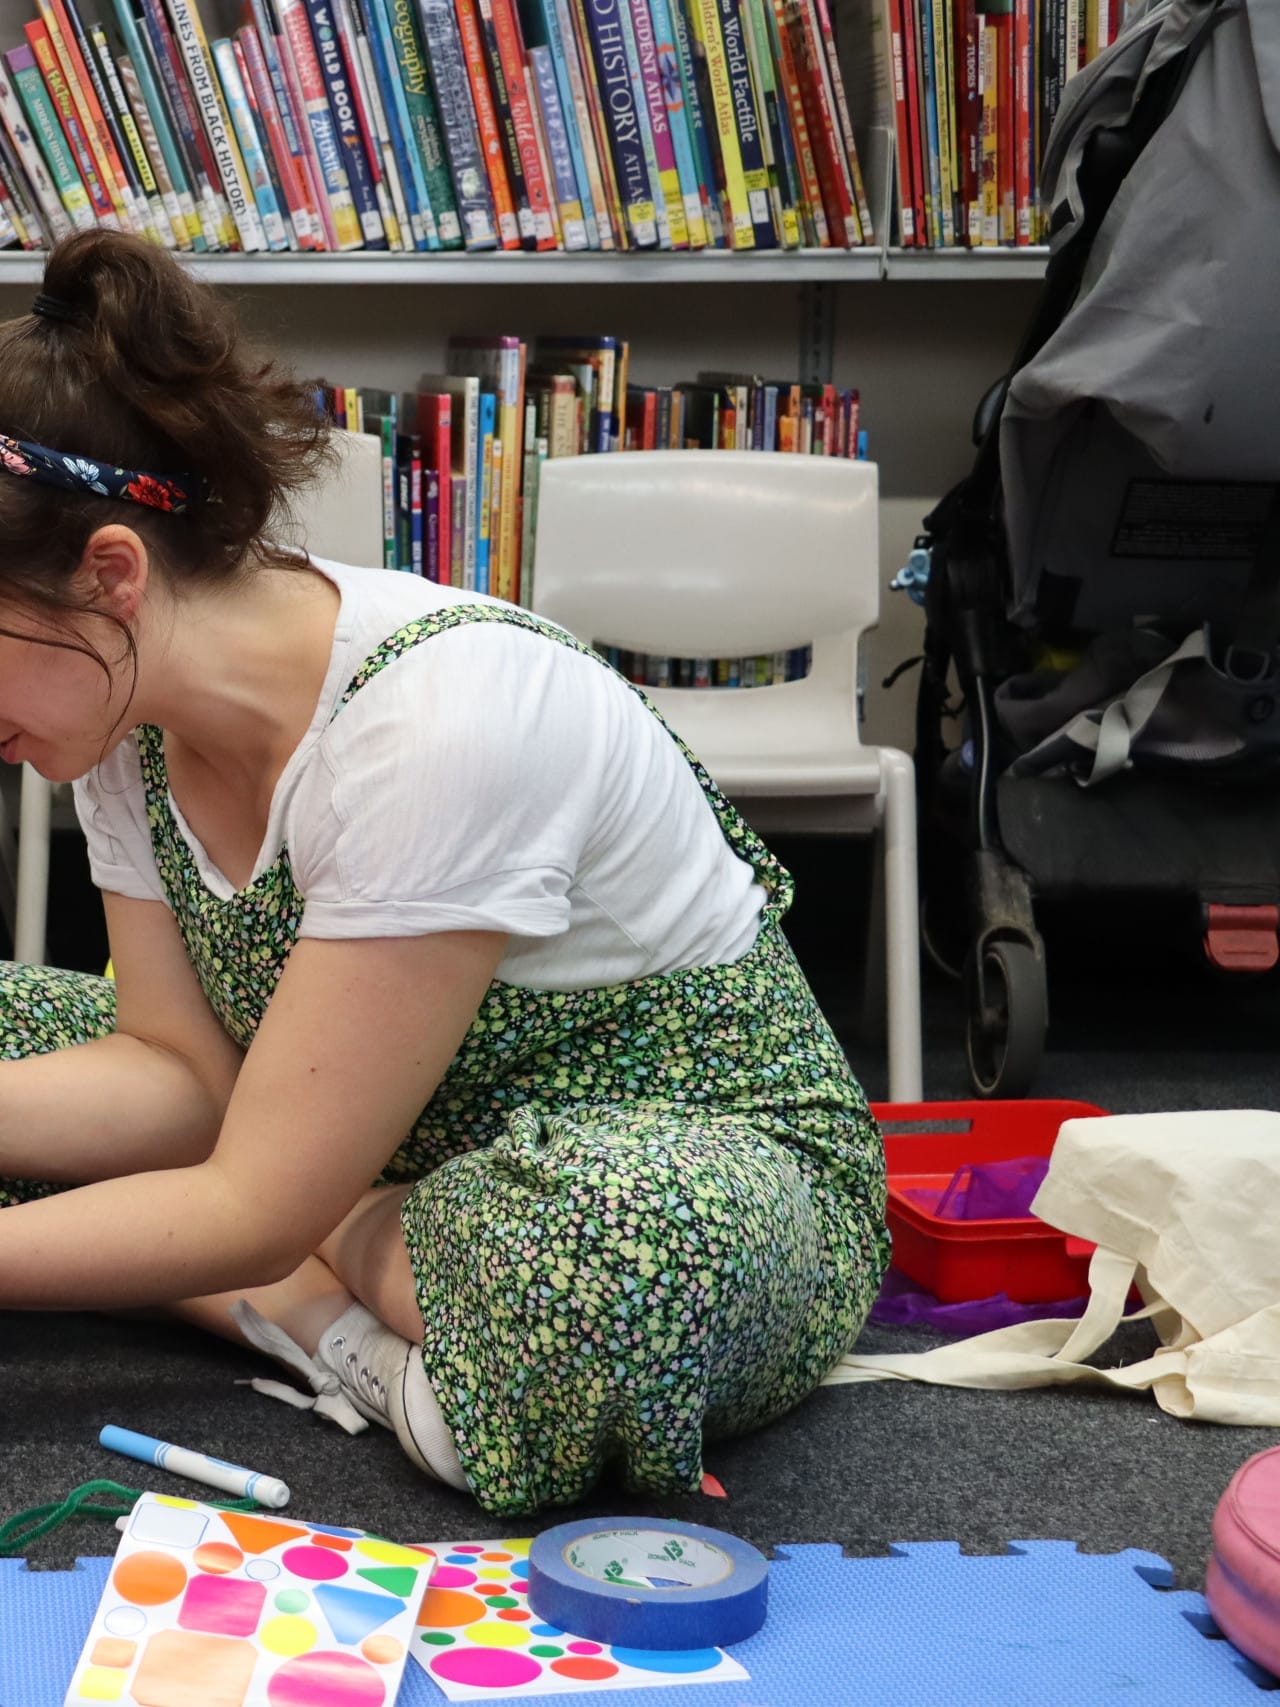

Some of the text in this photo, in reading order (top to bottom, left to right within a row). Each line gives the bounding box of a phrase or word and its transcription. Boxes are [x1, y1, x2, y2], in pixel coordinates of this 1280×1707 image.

[395, 1, 426, 95] eography
[697, 0, 736, 137] ildren's World Atlas
[719, 16, 760, 143] World Factfile
[966, 44, 975, 88] TUDORS
[173, 1, 248, 217] INES FROM BLACK HISTORY
[328, 77, 358, 134] BOOK
[599, 19, 639, 145] HISTORY
[623, 152, 644, 206] ATLAS
[641, 78, 670, 136] ATLAS
[520, 144, 542, 186] GIRL
